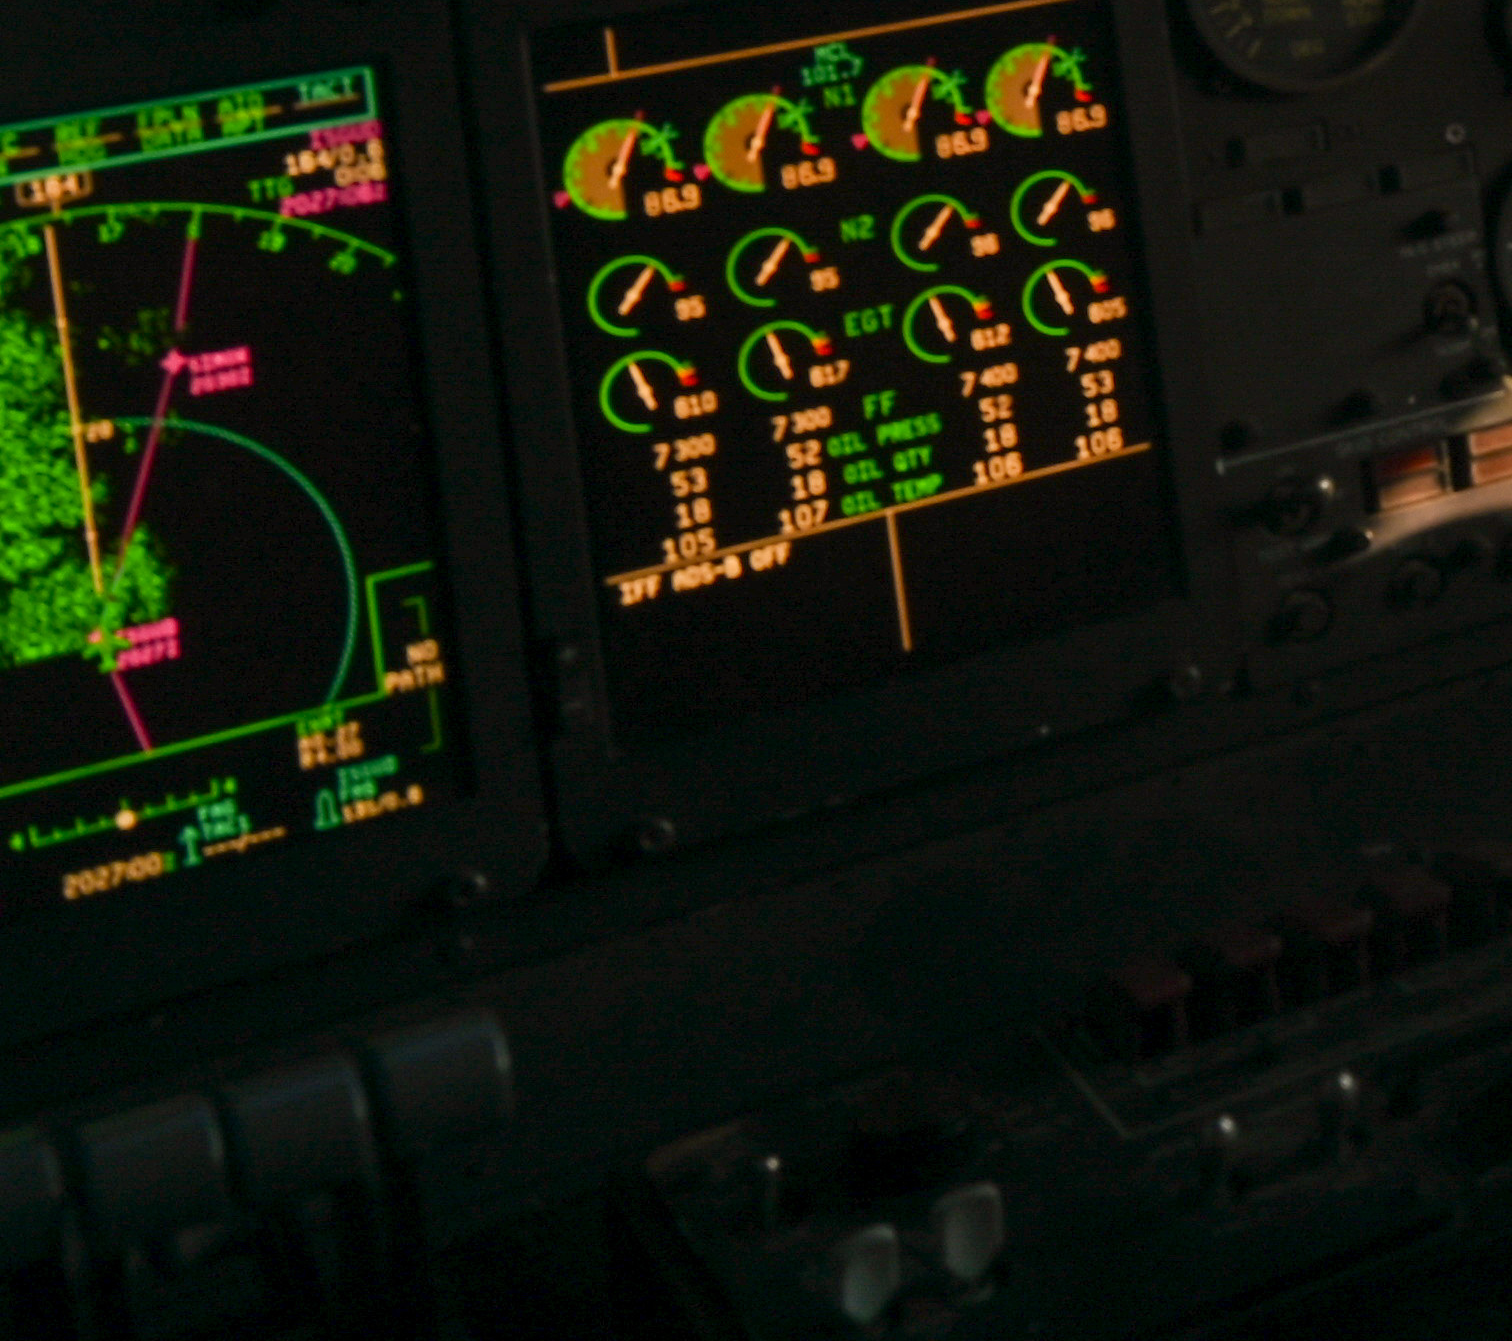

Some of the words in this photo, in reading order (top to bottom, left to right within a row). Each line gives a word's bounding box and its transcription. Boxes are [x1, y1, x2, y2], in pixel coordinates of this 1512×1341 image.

[822, 84, 856, 109] N1
[248, 176, 294, 202] TTG
[841, 214, 875, 243] N2
[843, 304, 895, 337] EGT
[1080, 369, 1115, 398] 53
[863, 389, 897, 419] FF
[826, 431, 867, 458] OIL
[876, 413, 942, 446] PRESS
[786, 439, 822, 469] 52
[843, 459, 884, 484] OIL
[893, 445, 932, 472] QTY
[670, 467, 708, 497] 53
[841, 490, 882, 516] OIL
[890, 473, 943, 503] TEMP
[778, 499, 829, 535] 107
[662, 527, 716, 564] 105
[619, 574, 661, 606] IFF
[750, 542, 791, 571] OFF
[407, 638, 439, 665] NO
[385, 661, 444, 695] PATH
